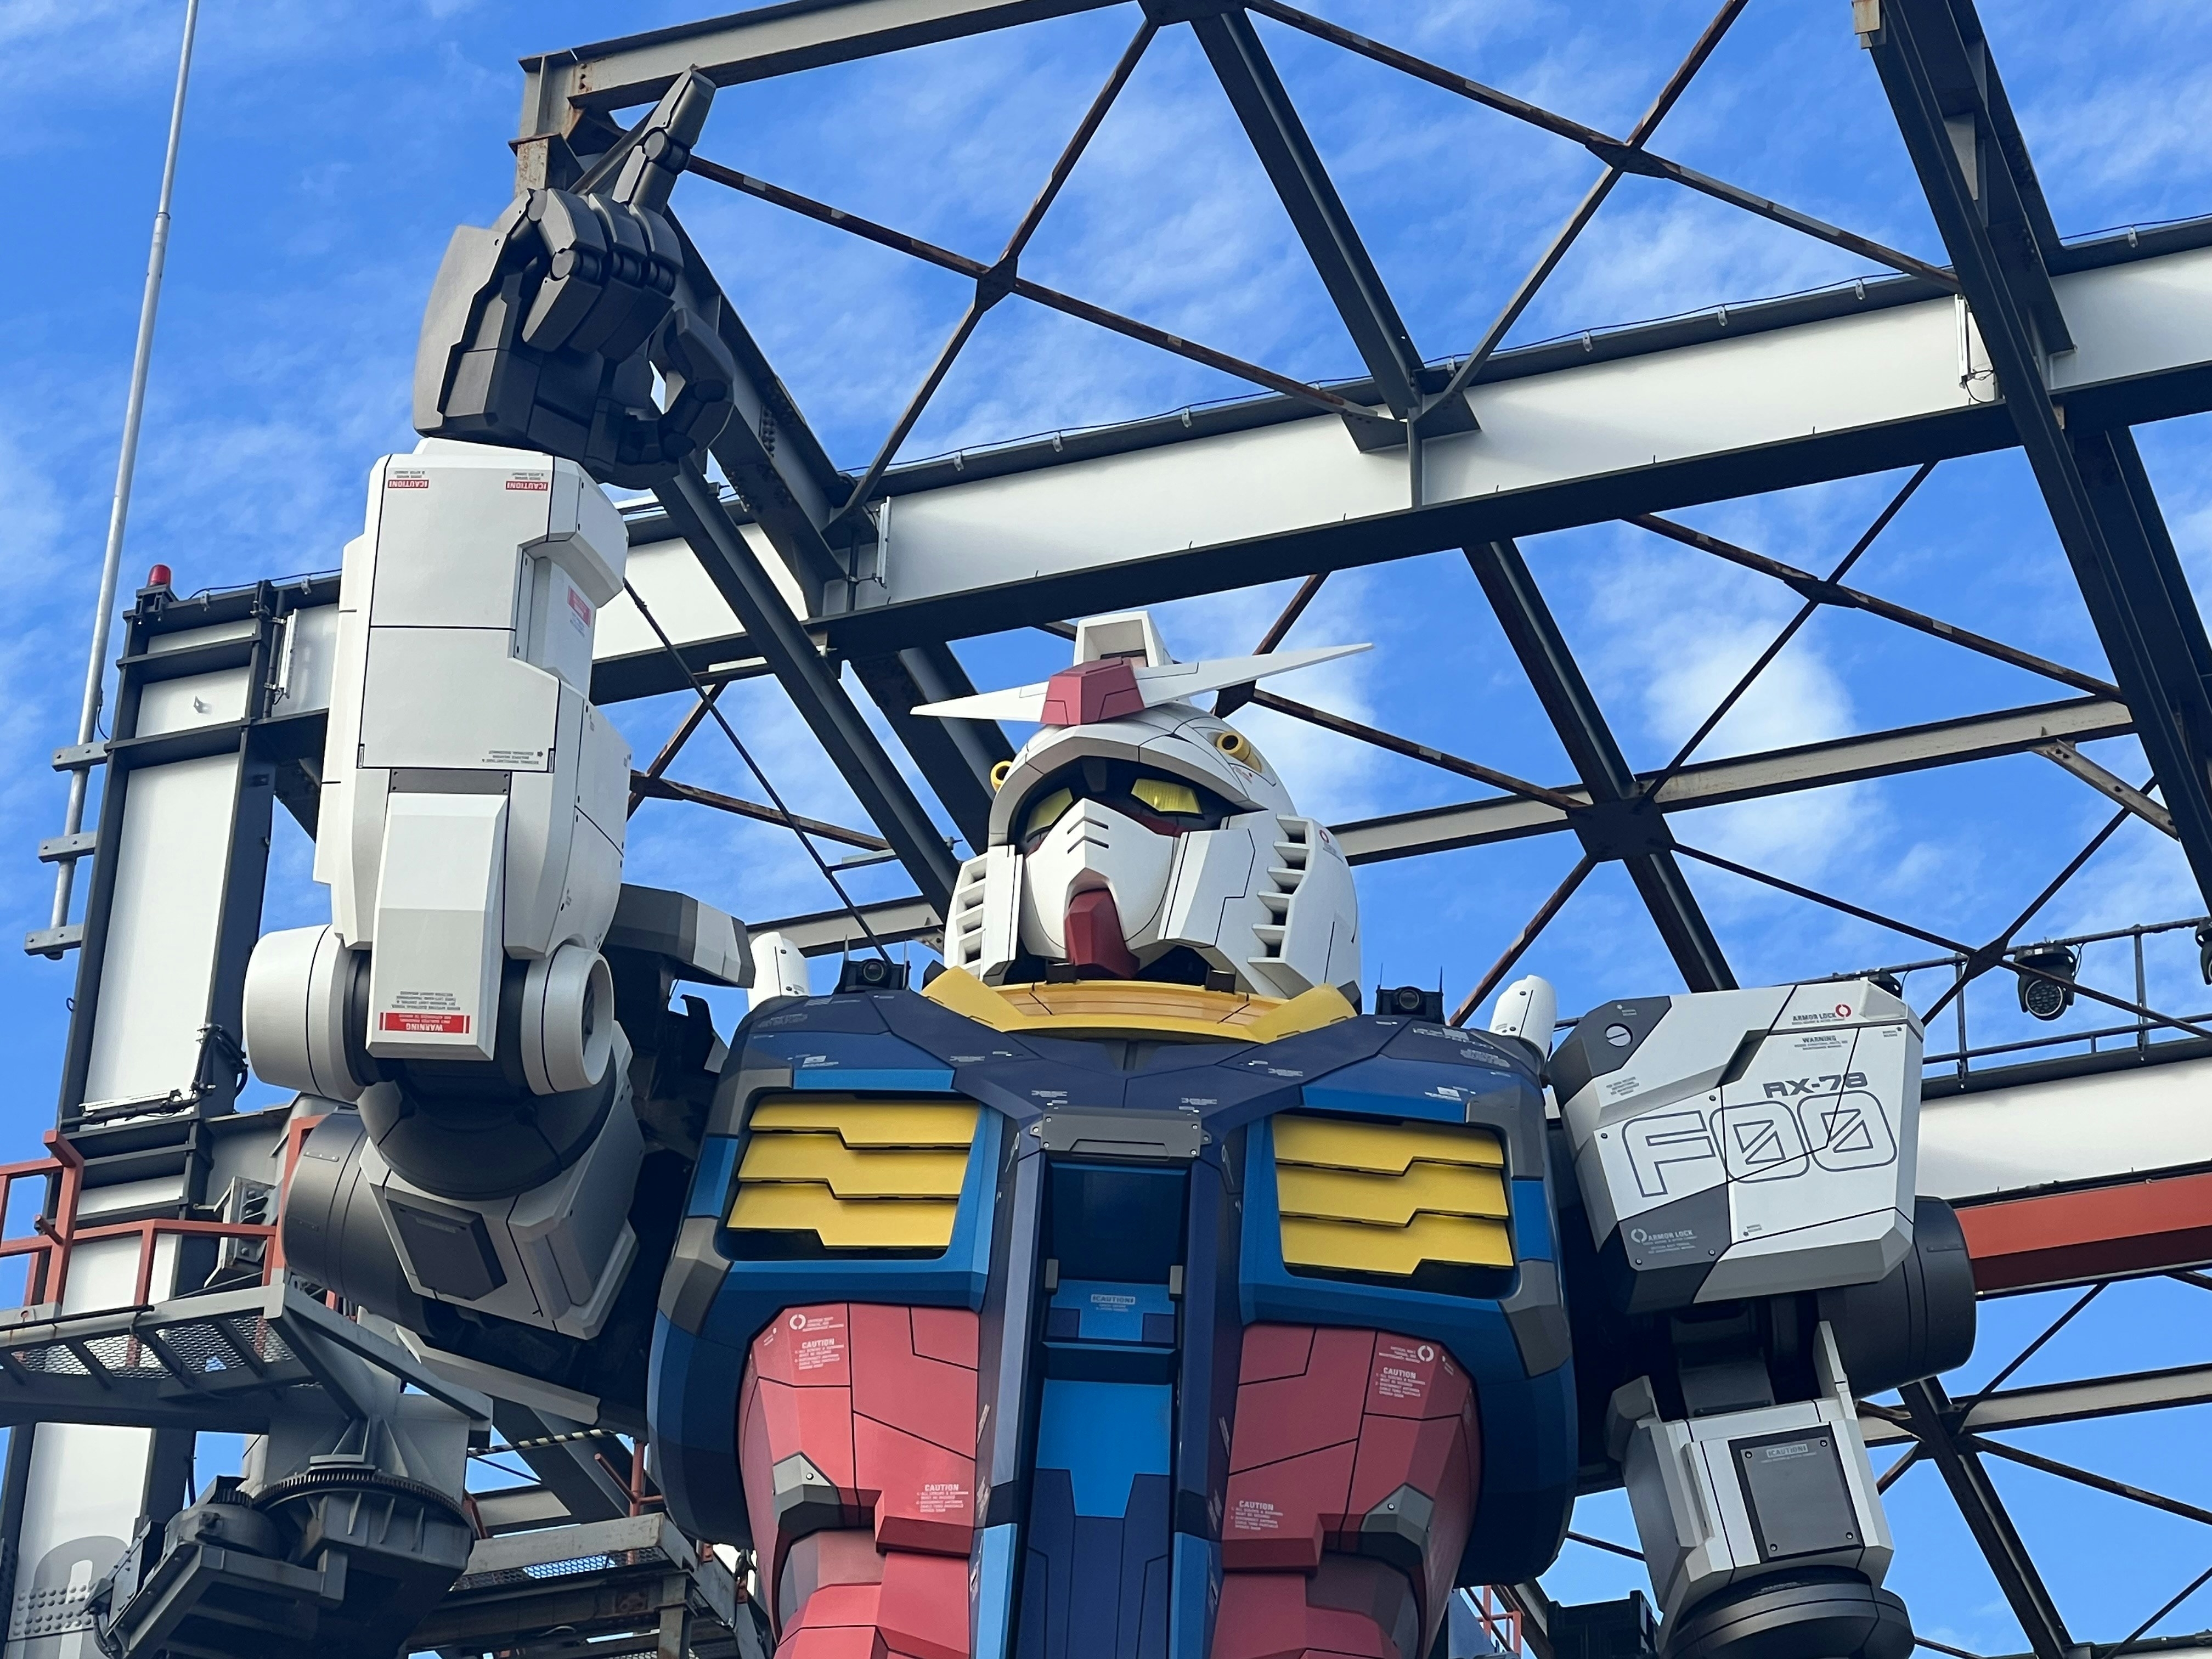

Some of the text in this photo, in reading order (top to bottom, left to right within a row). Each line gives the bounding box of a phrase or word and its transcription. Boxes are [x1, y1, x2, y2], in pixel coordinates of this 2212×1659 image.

[1792, 1013, 1818, 1022] ARMOR
[405, 1023, 443, 1032] WARNING
[1763, 1072, 1868, 1099] RX-78
[1647, 1232, 1674, 1242] ARMOR
[1675, 1229, 1694, 1238] LOCK
[802, 1338, 834, 1349] CAUTION
[1383, 1367, 1417, 1379] CAUTION
[924, 1483, 959, 1492] CAUTION
[1239, 1500, 1274, 1511] CAUTION
